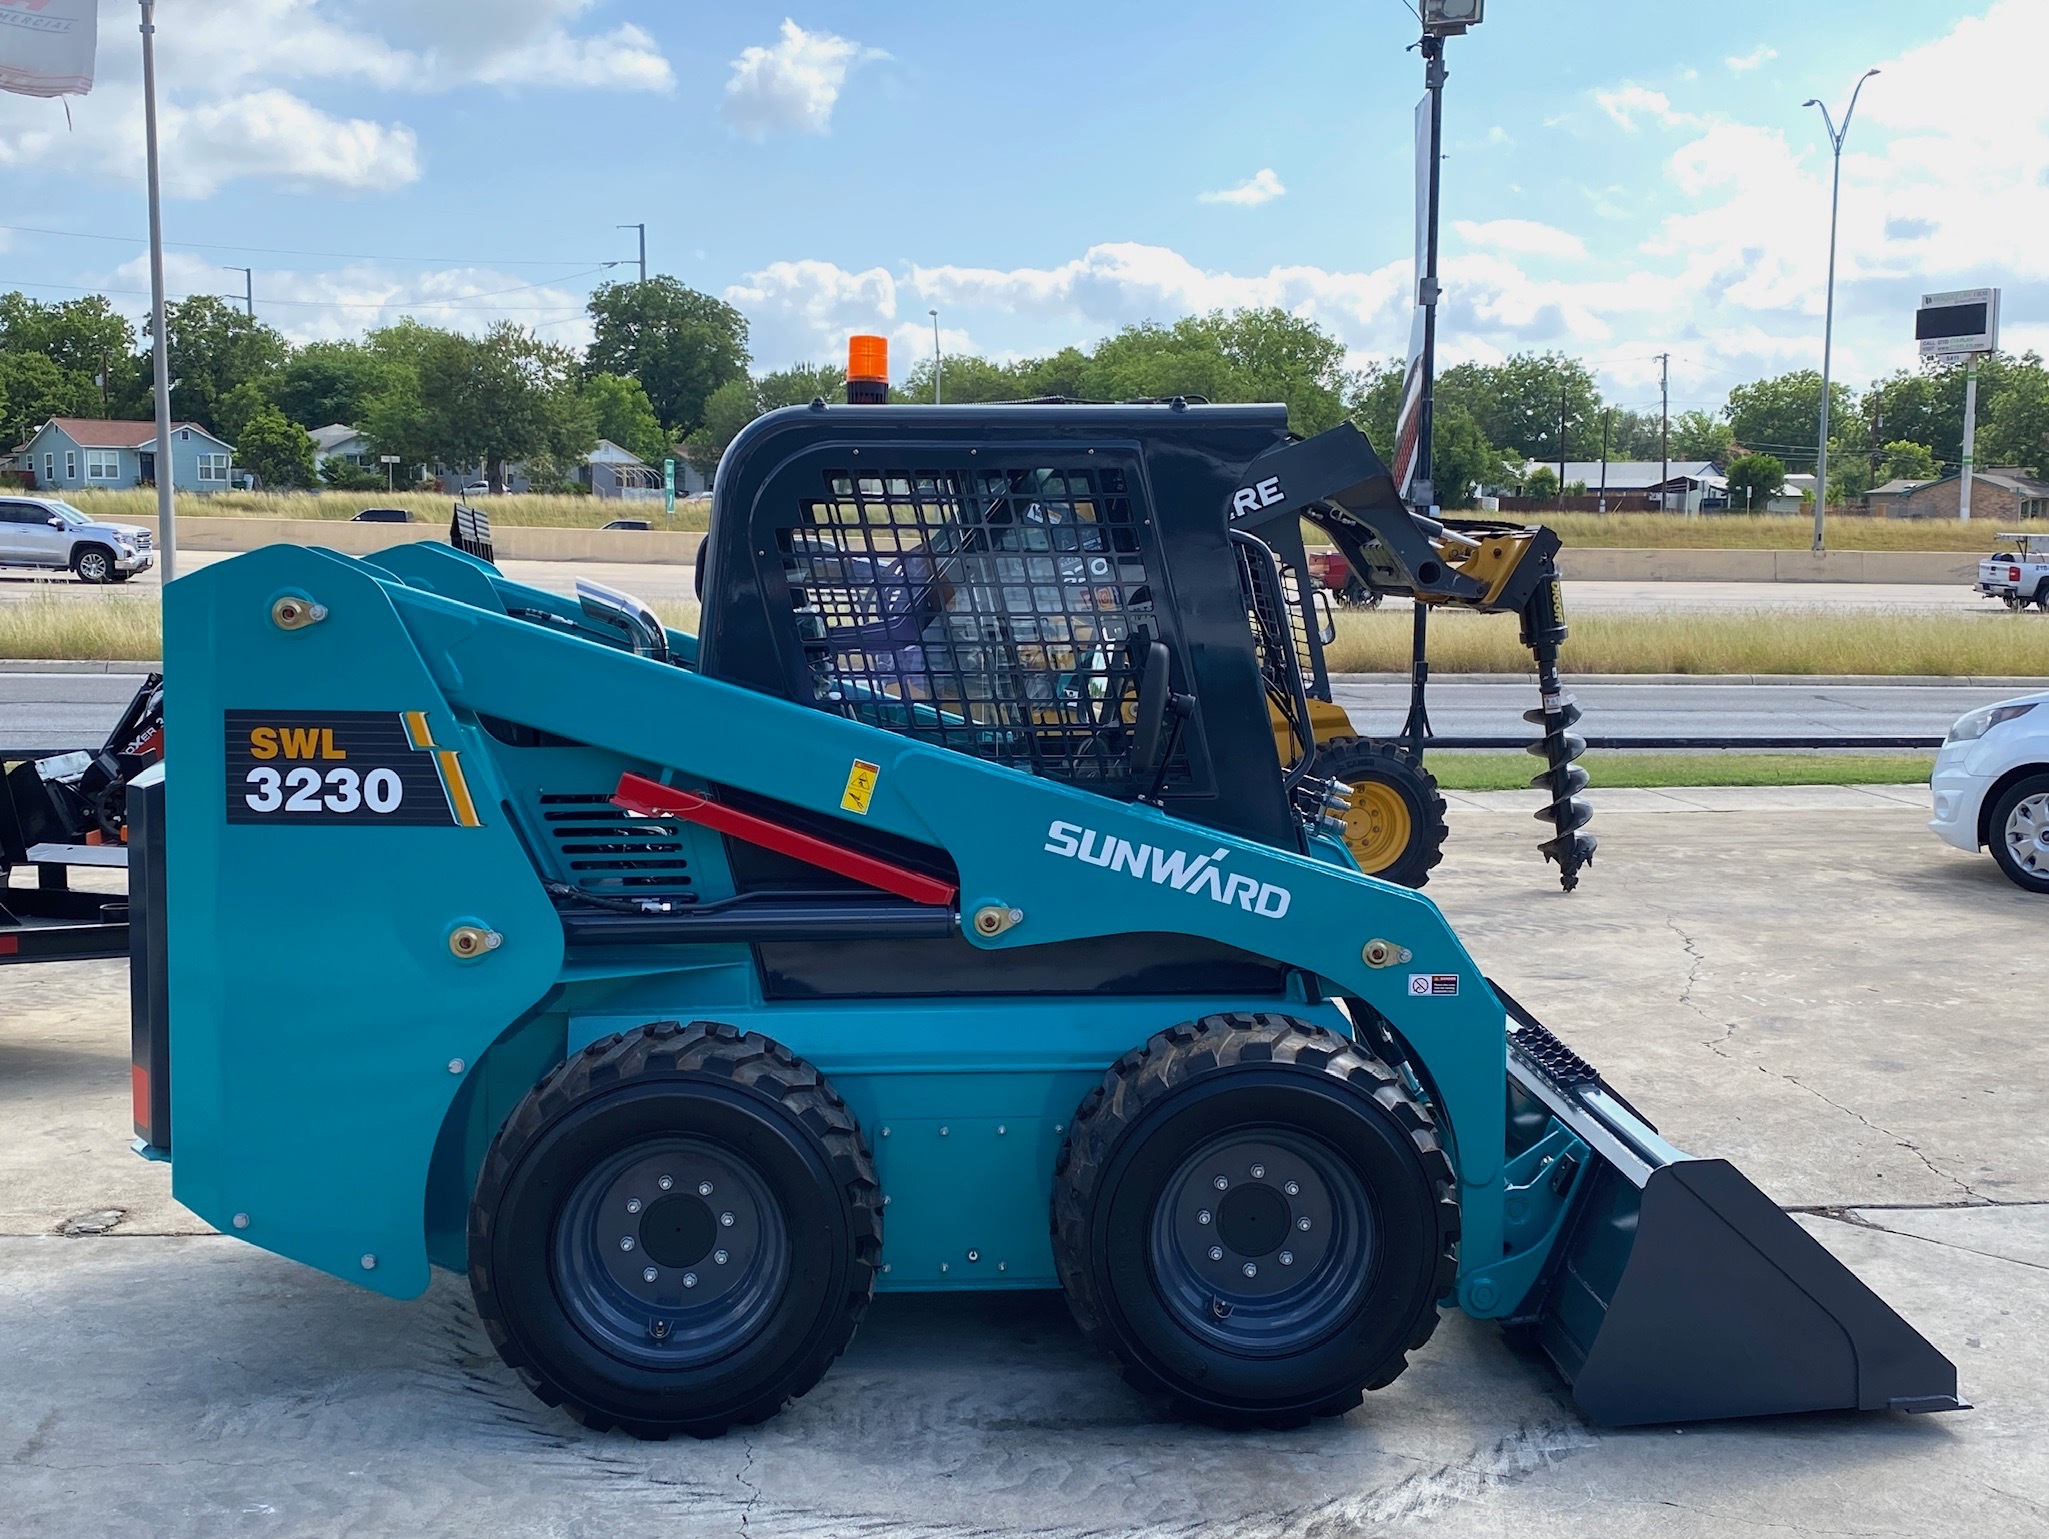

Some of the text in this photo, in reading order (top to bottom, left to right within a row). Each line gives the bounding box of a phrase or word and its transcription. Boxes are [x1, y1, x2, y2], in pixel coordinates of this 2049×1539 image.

[1229, 476, 1285, 520] RE
[250, 727, 347, 760] SWL
[245, 766, 403, 814] 3230
[1044, 820, 1292, 919] SUNWARD
